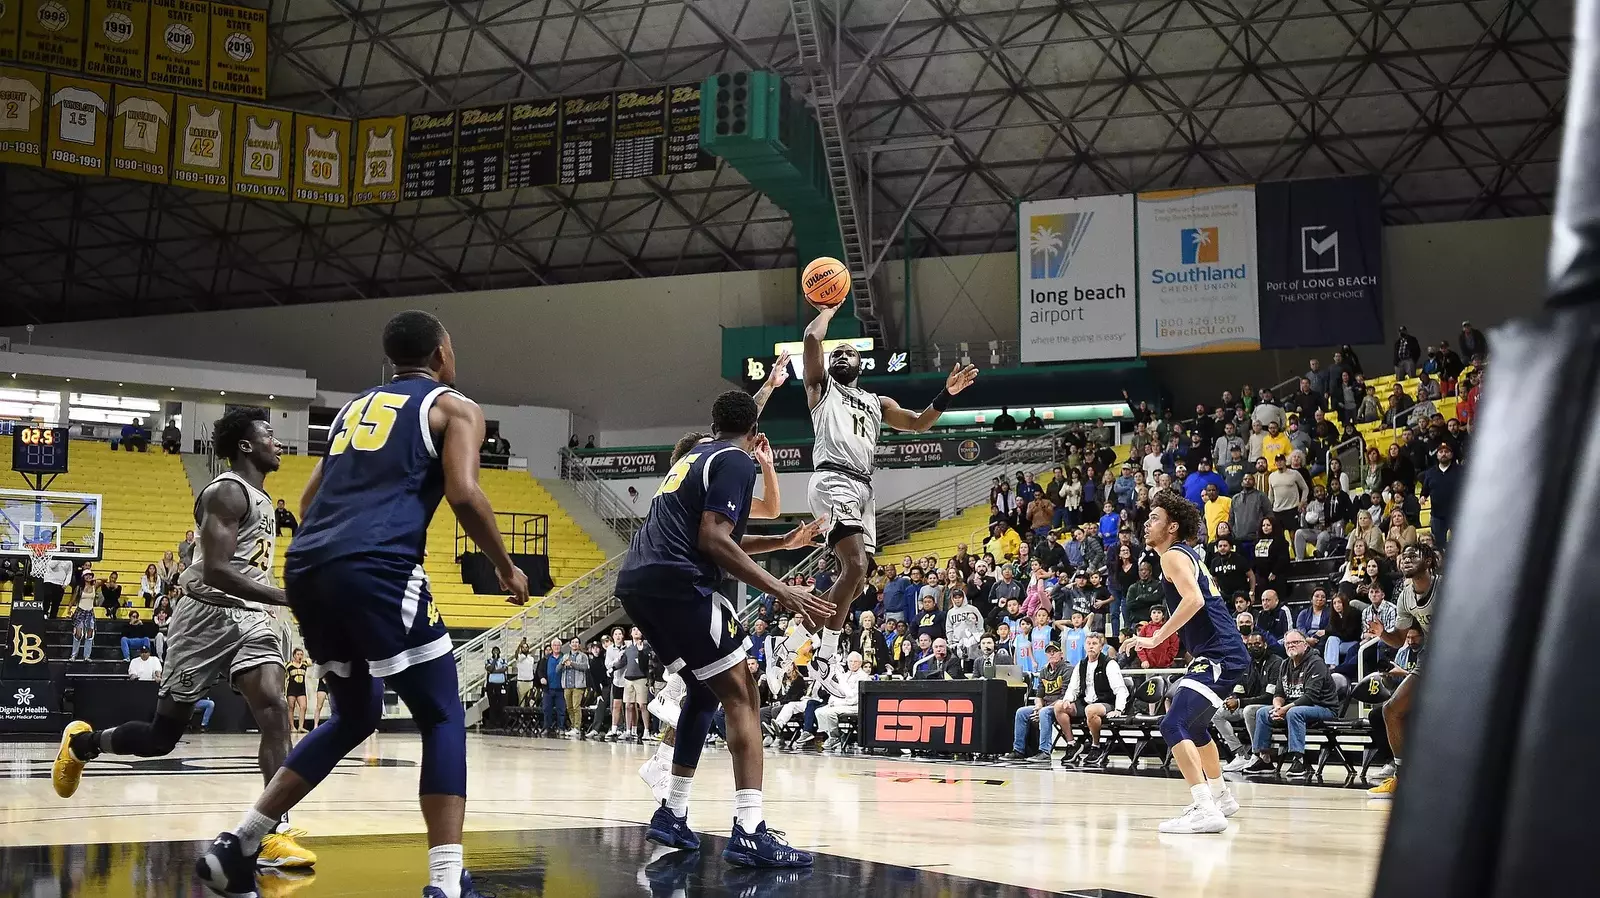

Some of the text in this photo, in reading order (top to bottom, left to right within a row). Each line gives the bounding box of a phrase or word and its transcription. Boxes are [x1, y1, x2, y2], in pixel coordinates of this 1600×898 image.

[106, 0, 132, 11] STATE
[180, 0, 206, 13] BEACH
[39, 10, 66, 22] 1998
[167, 9, 193, 22] STATE
[213, 6, 264, 22] LONG BEACH
[105, 21, 131, 34] 1991
[226, 20, 251, 31] STATE
[167, 32, 191, 45] 2018
[38, 41, 64, 54] NCAA
[228, 41, 252, 53] 2019
[22, 50, 79, 68] CHAMPIONS
[103, 53, 128, 65] NCAA
[88, 61, 142, 78] CHAMPIONS
[166, 63, 191, 76] NCAA
[151, 72, 203, 88] CHAMPIONS
[226, 72, 250, 83] NCAA
[0, 90, 27, 102] SCOTT
[212, 81, 263, 96] CHAMPIONS
[63, 99, 95, 113] WINSLOW
[565, 95, 610, 116] Beach
[617, 90, 664, 109] Beach
[6, 102, 18, 119] 2
[462, 106, 505, 126] Beach
[512, 101, 557, 120] Beach
[69, 112, 87, 126] 15
[411, 112, 455, 131] Beach
[137, 121, 147, 139] 7
[190, 138, 215, 158] 42
[51, 150, 101, 169] 1988-1991
[114, 158, 165, 175] 1990-1993
[251, 152, 274, 171] 20
[312, 160, 333, 180] 30
[369, 160, 387, 178] 32
[175, 170, 227, 185] 1969-1973
[805, 268, 835, 289] Wilson
[1152, 264, 1246, 284] Southland
[1161, 282, 1237, 294] CREDIT UNION
[1266, 275, 1377, 292] Port of LONG BEACH
[1030, 283, 1126, 306] long beach
[1280, 289, 1365, 303] THE PORT OF CHOICE
[1030, 306, 1084, 325] airport
[1030, 334, 1055, 344] where
[1056, 333, 1070, 343] the
[1071, 333, 1095, 345] going
[1096, 333, 1102, 342] is
[329, 391, 411, 456] 35
[852, 413, 866, 438] 11
[21, 428, 54, 445] 02.5
[773, 448, 801, 460] YOTA
[874, 443, 943, 455] BE TOYOTA
[616, 454, 656, 466] TOYOTA
[782, 459, 801, 467] 1966
[903, 454, 921, 463] Since
[924, 454, 941, 462] 1966
[621, 465, 637, 473] Since
[639, 465, 655, 473] 1966
[248, 538, 271, 572] 25
[951, 612, 969, 625] UCS
[11, 624, 45, 664] LB
[1034, 641, 1045, 649] 24
[1071, 641, 1077, 650] 4
[1020, 648, 1029, 658] 31
[0, 706, 24, 715] Dignity
[875, 699, 975, 745] ESPN
